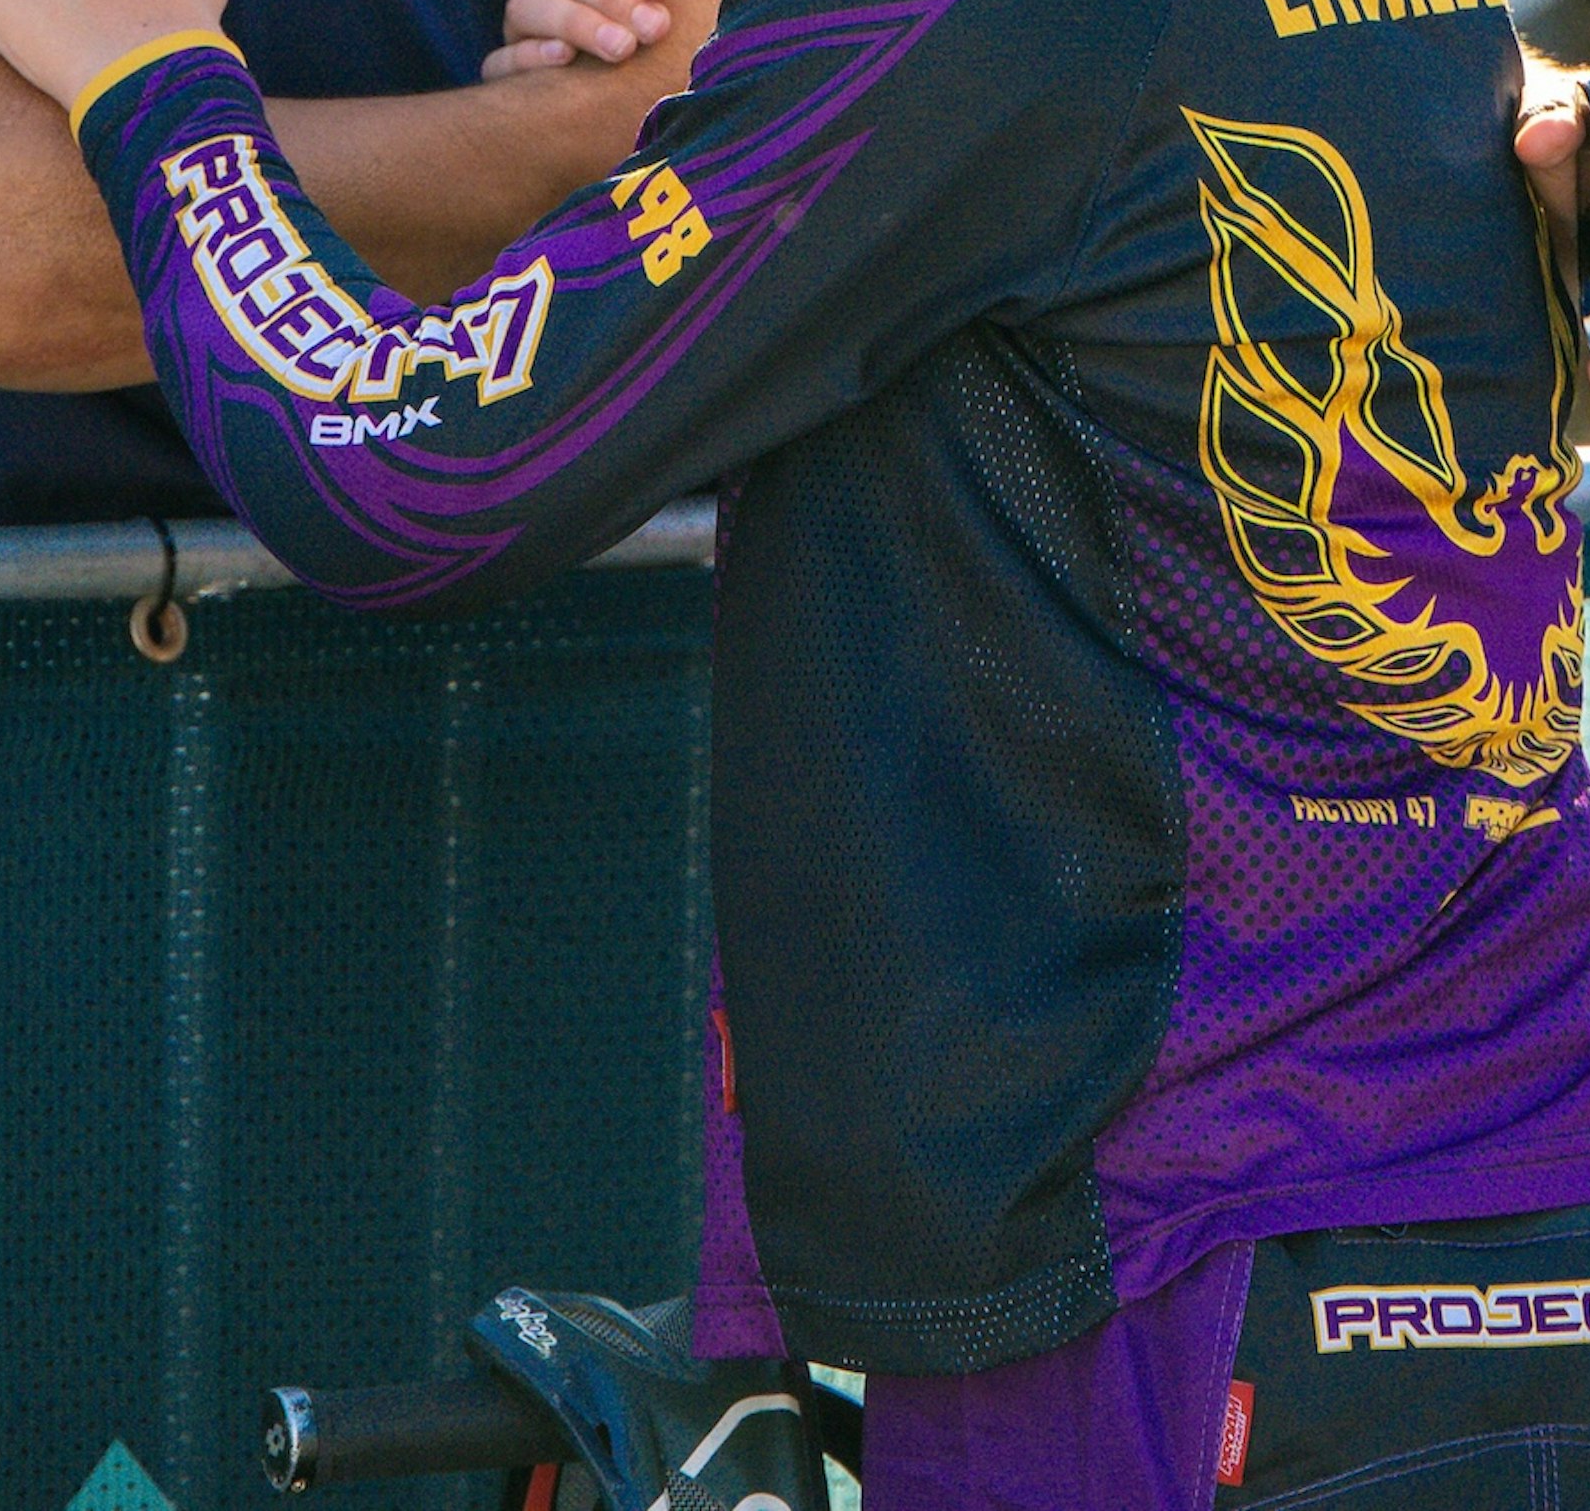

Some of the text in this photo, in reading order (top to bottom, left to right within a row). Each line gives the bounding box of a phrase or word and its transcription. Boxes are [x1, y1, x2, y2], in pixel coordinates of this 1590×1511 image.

[310, 396, 443, 446] BMX
[1289, 794, 1436, 828] FACTORY 47
